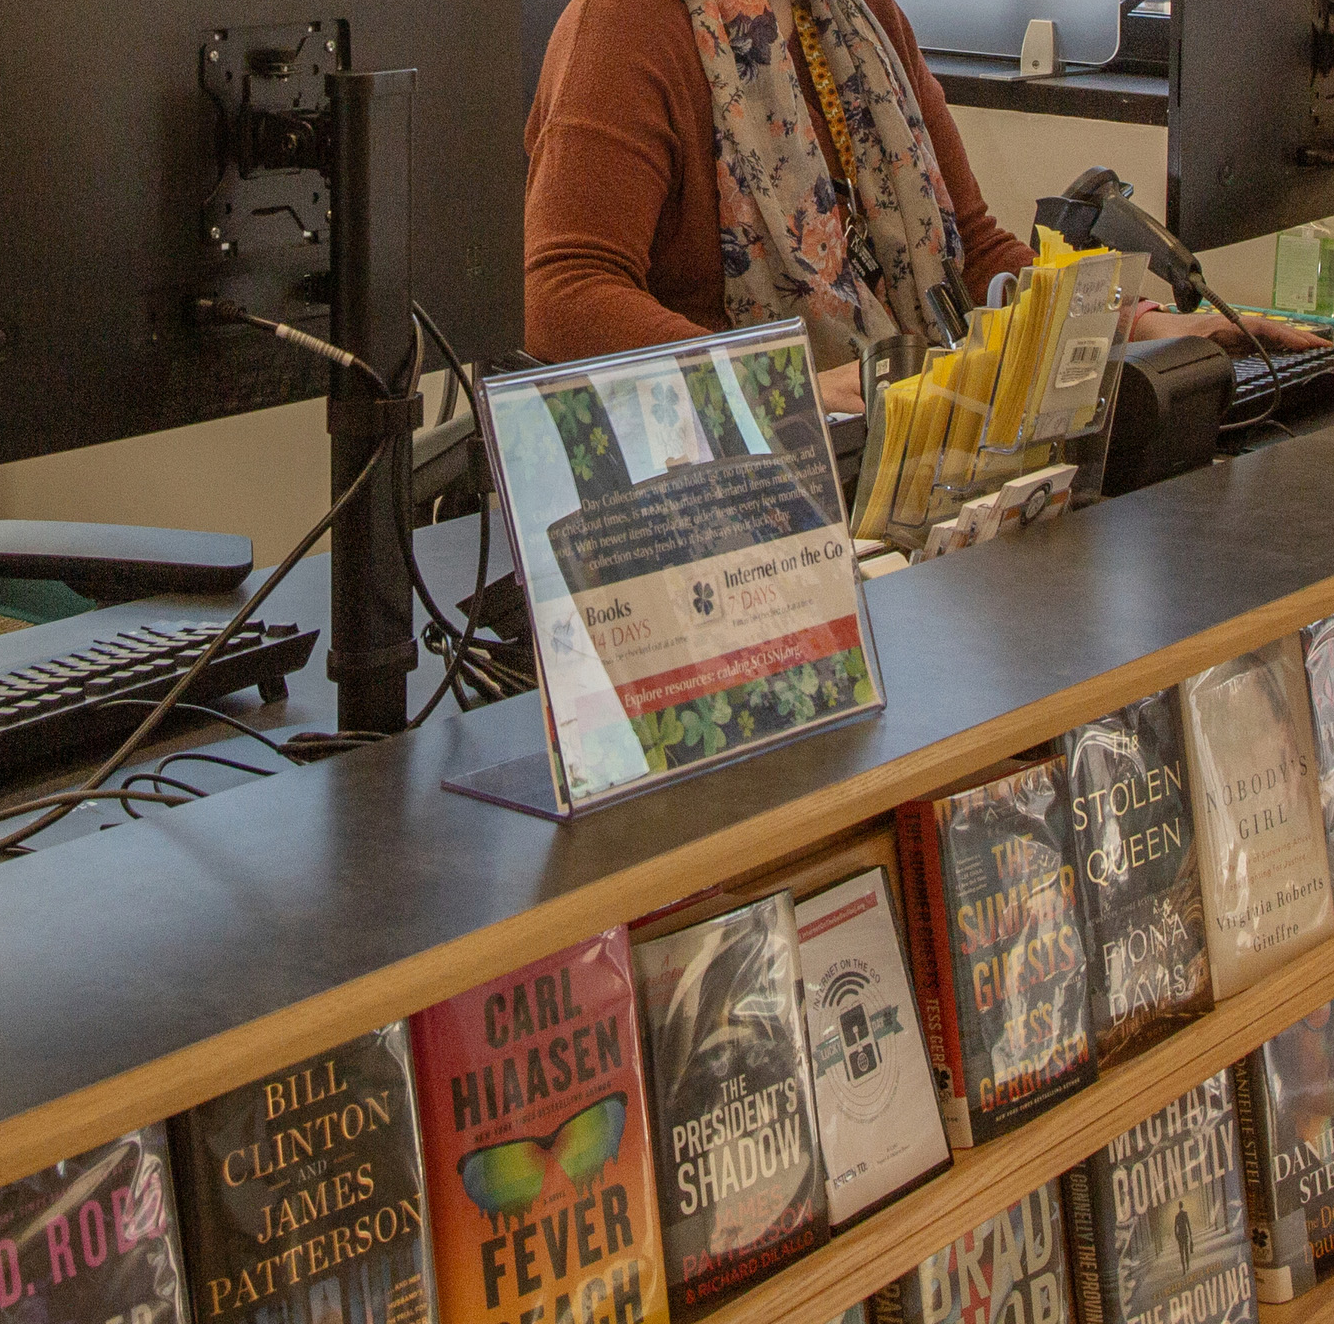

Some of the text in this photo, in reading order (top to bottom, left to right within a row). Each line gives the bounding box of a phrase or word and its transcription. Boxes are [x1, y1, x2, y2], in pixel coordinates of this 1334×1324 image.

[562, 516, 602, 537] checkout
[632, 508, 640, 518] is
[750, 477, 771, 491] items
[581, 497, 601, 514] Day
[602, 485, 651, 506] Collection,
[723, 467, 734, 479] no
[736, 460, 762, 480] option
[800, 445, 815, 461] and
[576, 538, 598, 554] With
[599, 533, 628, 547] newer
[629, 522, 653, 540] items
[739, 499, 761, 513] every
[762, 495, 777, 509] few
[810, 482, 823, 495] the
[589, 548, 633, 570] collection
[633, 544, 654, 561] stays
[654, 537, 677, 561] fresh
[723, 540, 843, 588] Internet on the Go
[586, 597, 632, 627] Books
[728, 596, 736, 614] 7
[741, 584, 777, 610] DAYS
[611, 619, 652, 648] DAYS
[624, 686, 663, 710] Explore
[665, 672, 716, 699] resources:
[1110, 728, 1140, 759] The
[1072, 760, 1183, 831] STOLEN
[1206, 755, 1308, 814] NOBODY'S
[1087, 817, 1182, 887] QUEEN
[1239, 804, 1288, 841] GIRL
[991, 833, 1037, 880] THE
[957, 864, 1077, 956] SUMMER
[1216, 898, 1272, 933] Virginia
[1276, 877, 1325, 908] Roberts
[1102, 913, 1189, 976] FIONA
[1253, 923, 1300, 953] Giuffre
[813, 958, 881, 1012] INTERNET ON THE GO
[973, 925, 1076, 1013] GUESTS
[1110, 964, 1188, 1026] DAVIS
[484, 967, 582, 1050] CARL
[926, 998, 942, 1034] TESS
[1004, 1002, 1055, 1051] TESS
[263, 1060, 347, 1121] BILL
[451, 1015, 623, 1133] HIAASEN
[720, 1073, 747, 1103] THE
[979, 1031, 1090, 1114] GERRITSEN
[222, 1090, 391, 1188] CLINTON
[672, 1076, 798, 1163] PRESIDENT'S
[1233, 1057, 1259, 1184] DANIELLE STEEL
[296, 1160, 328, 1184] AND
[677, 1113, 800, 1216] SHADOW
[1113, 1119, 1234, 1224] CONNELLY
[257, 1163, 375, 1244] JAMES
[712, 1184, 784, 1240] JAMES
[208, 1193, 423, 1318] PATTERSON
[481, 1183, 634, 1310] FEVER
[682, 1198, 814, 1283] PATTERSON
[918, 1184, 1053, 1324] BRAD
[1077, 1245, 1098, 1270] THE
[697, 1257, 758, 1298] RICHARD
[1169, 1261, 1252, 1324] PROVING
